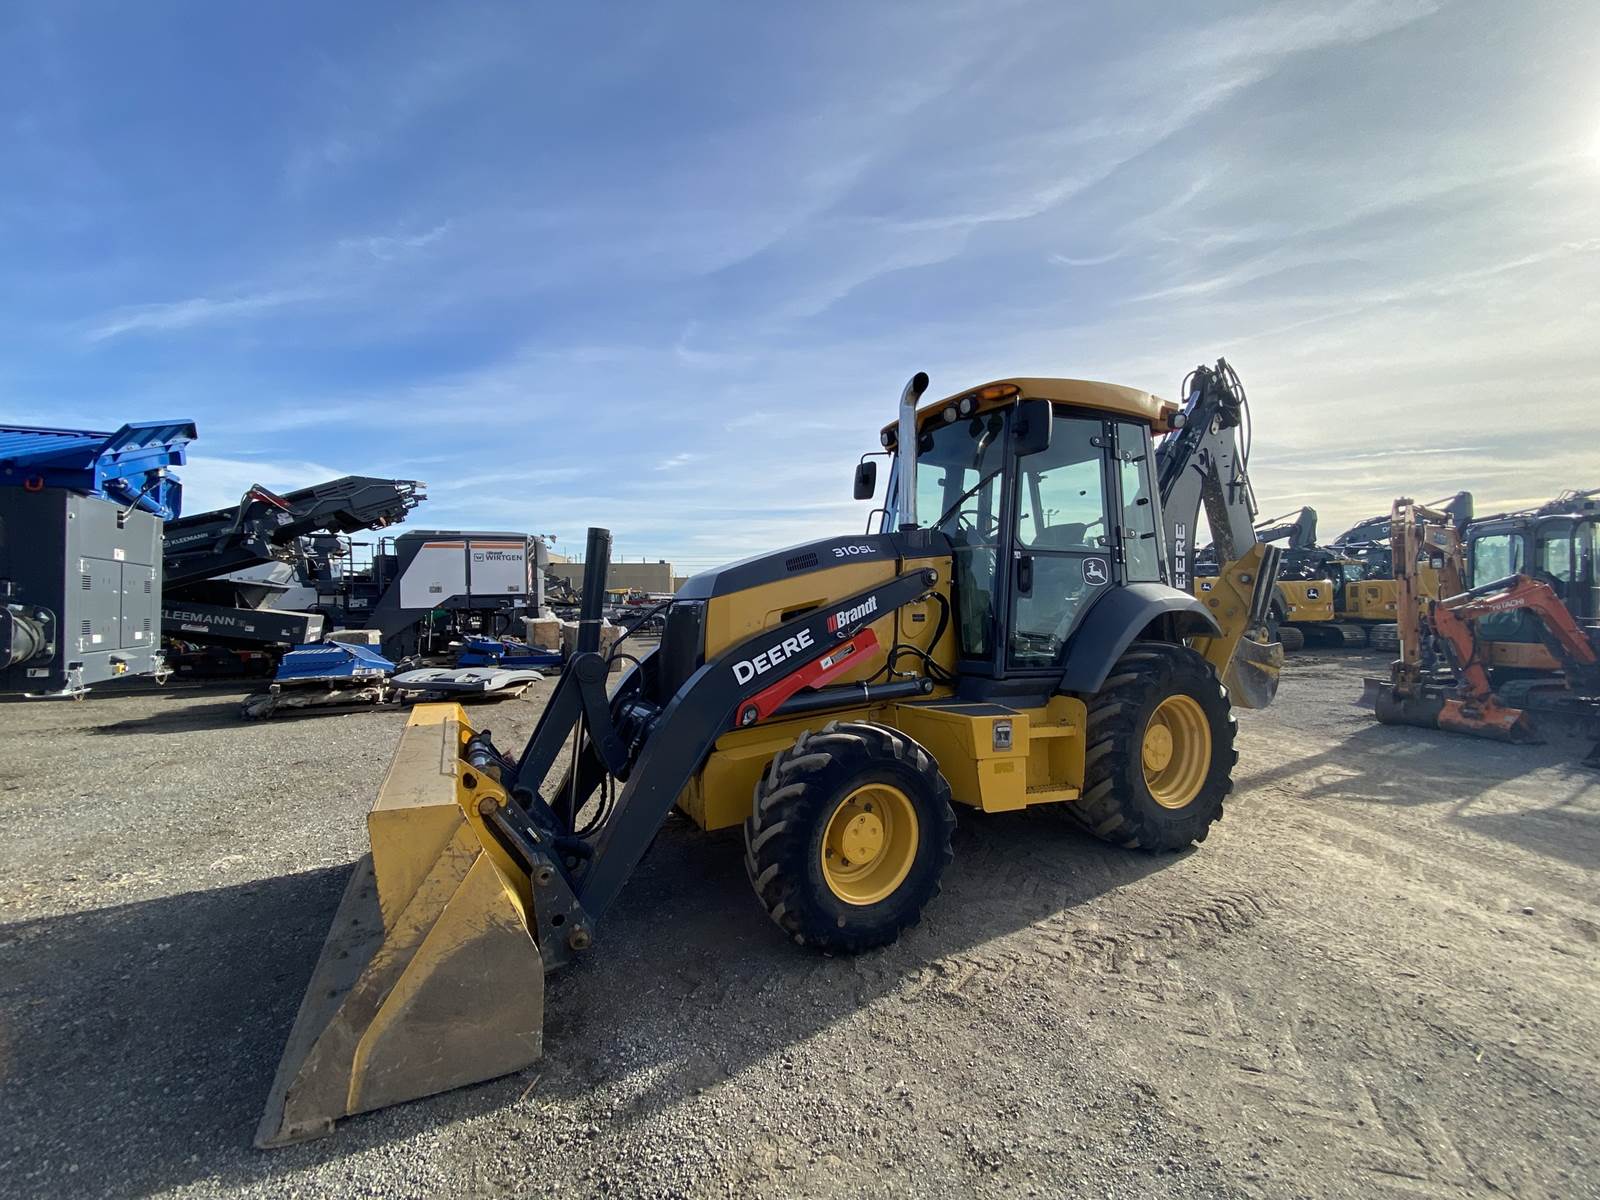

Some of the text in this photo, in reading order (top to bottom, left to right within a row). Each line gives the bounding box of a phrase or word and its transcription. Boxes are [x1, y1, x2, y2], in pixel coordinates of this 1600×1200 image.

[171, 532, 209, 545] KLEEMANN
[485, 553, 522, 561] WIRTGEN
[831, 544, 876, 557] 310SL
[836, 595, 878, 629] Brandt
[732, 628, 815, 686] DEERE
